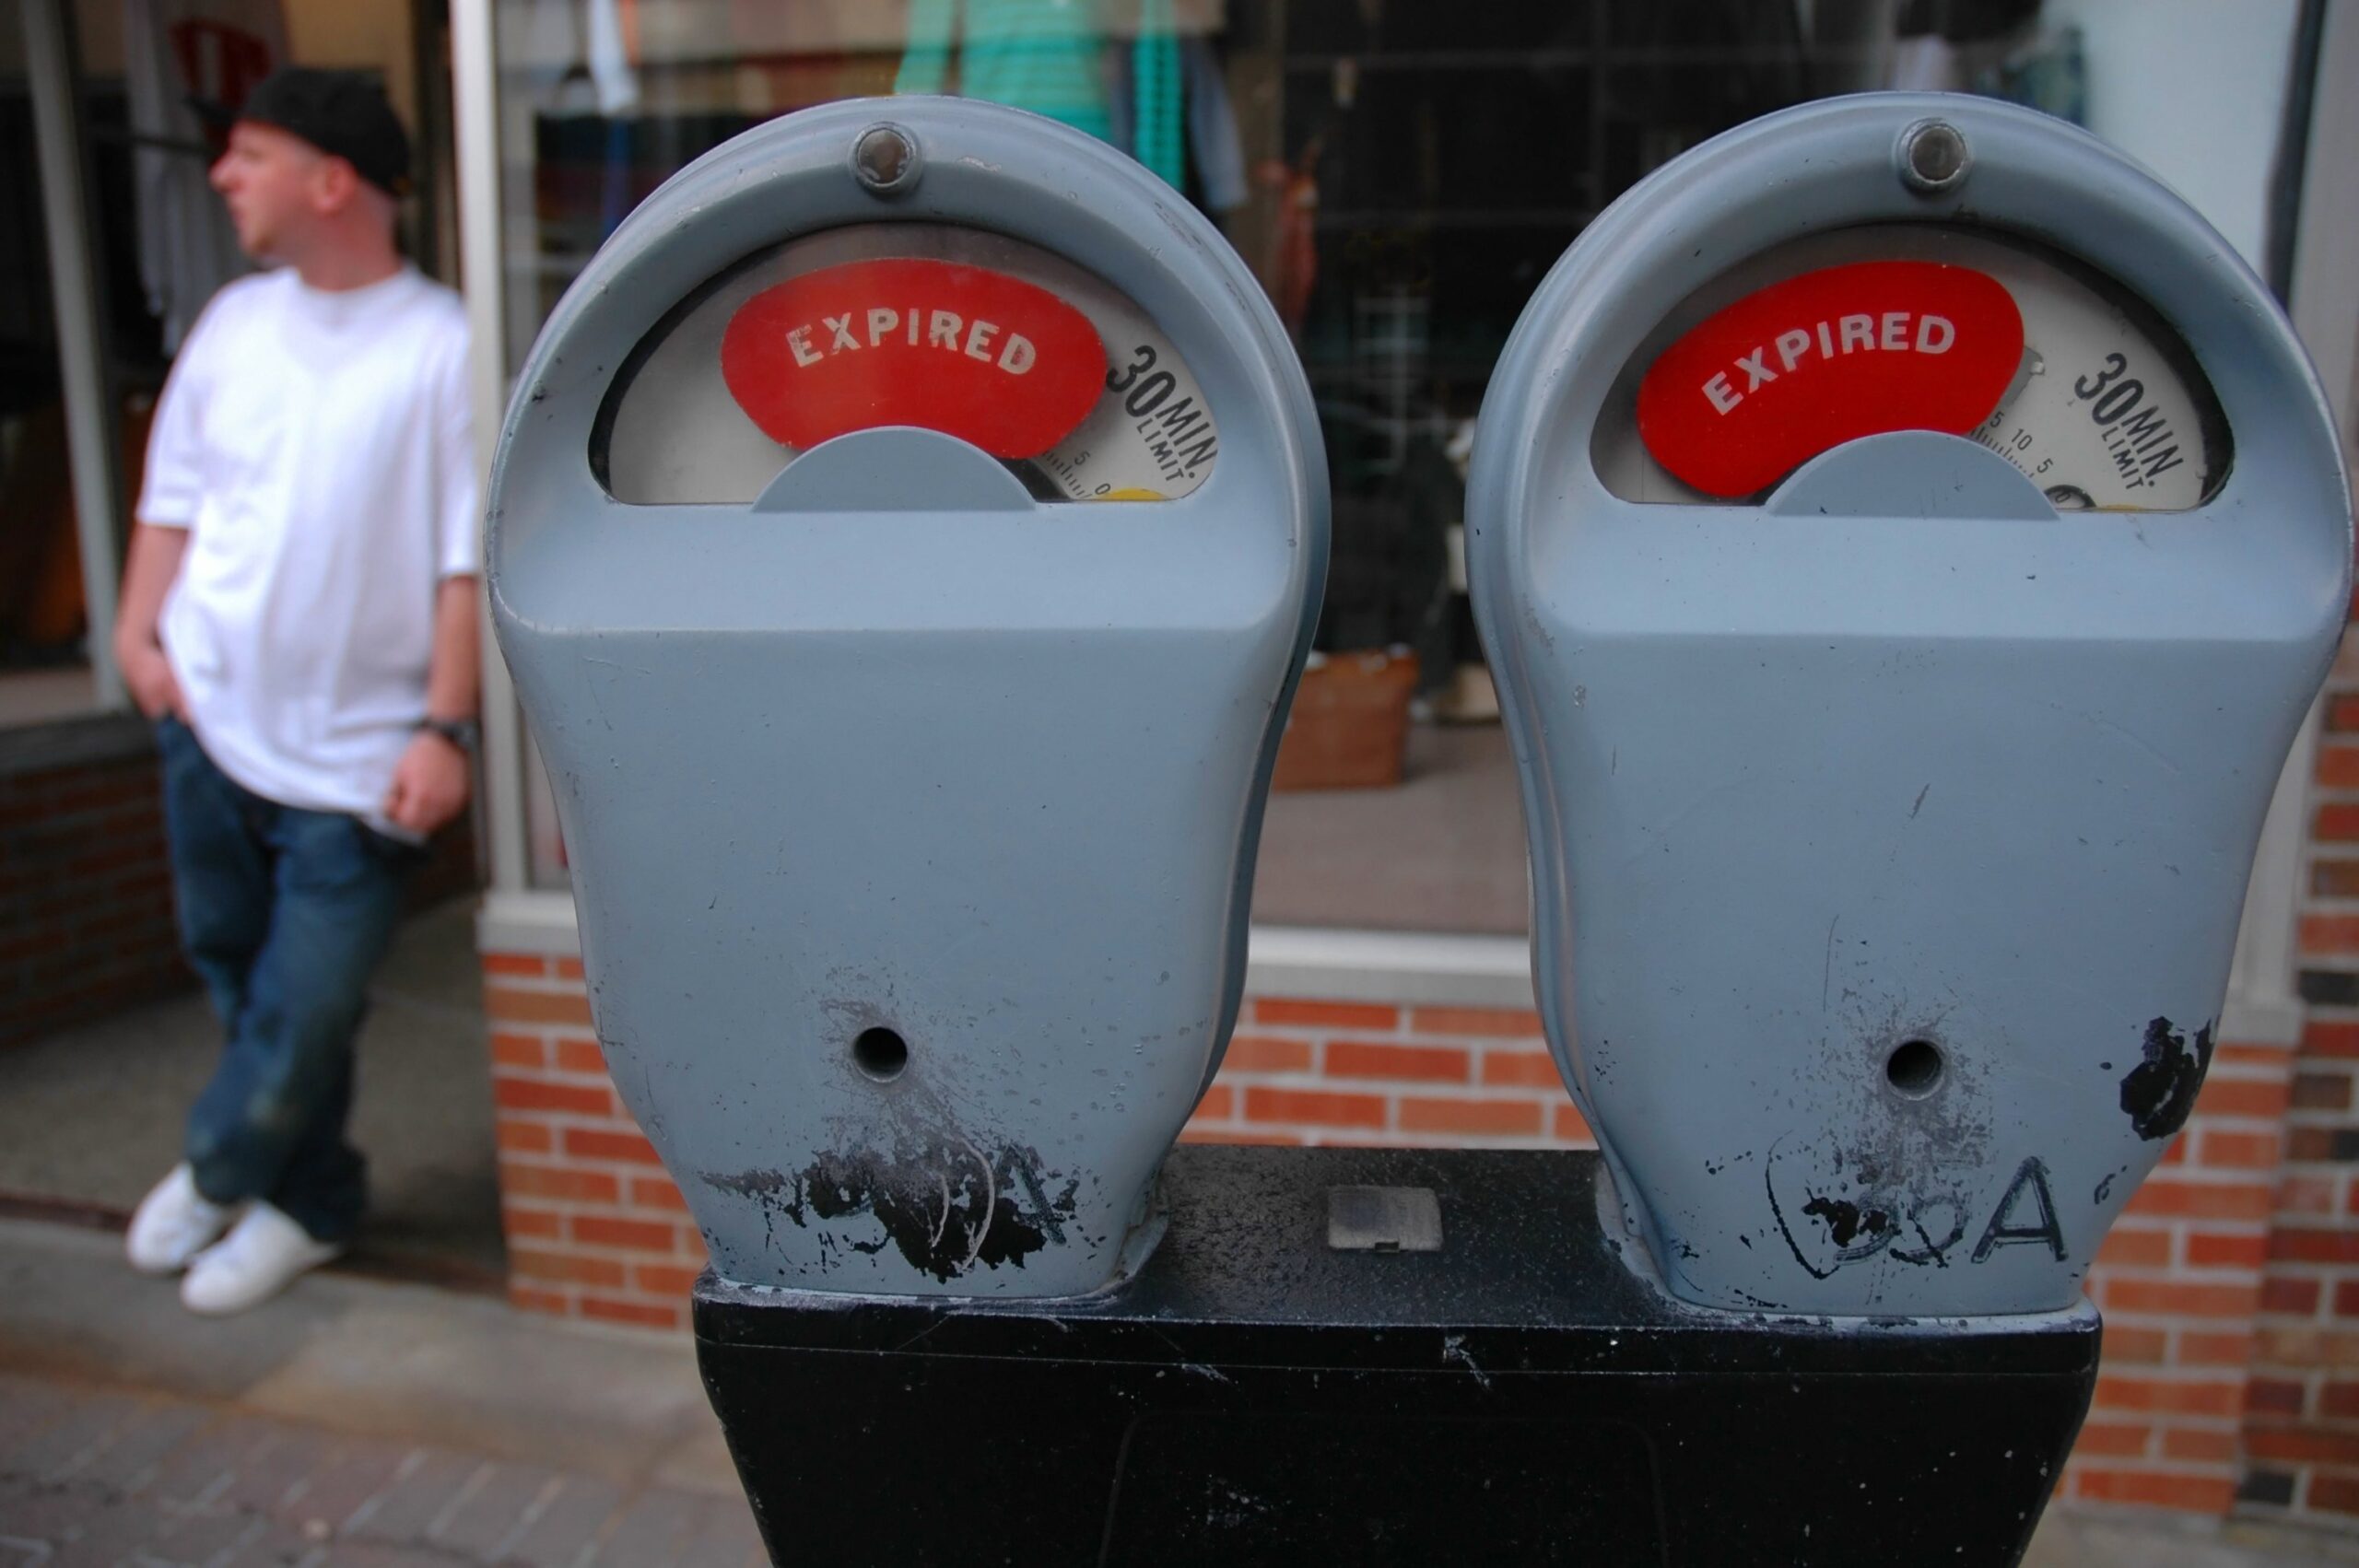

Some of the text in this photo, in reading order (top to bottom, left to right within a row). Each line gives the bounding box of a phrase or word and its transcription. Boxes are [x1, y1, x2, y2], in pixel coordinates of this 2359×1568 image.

[786, 308, 1036, 375] EXPIRED
[1701, 312, 1955, 415] EXPIRED
[1074, 450, 1090, 467] 5
[1136, 417, 1184, 482] LIMIT
[2011, 428, 2033, 451] 10
[2036, 458, 2054, 474] 5
[2101, 427, 2144, 489] LIMIT
